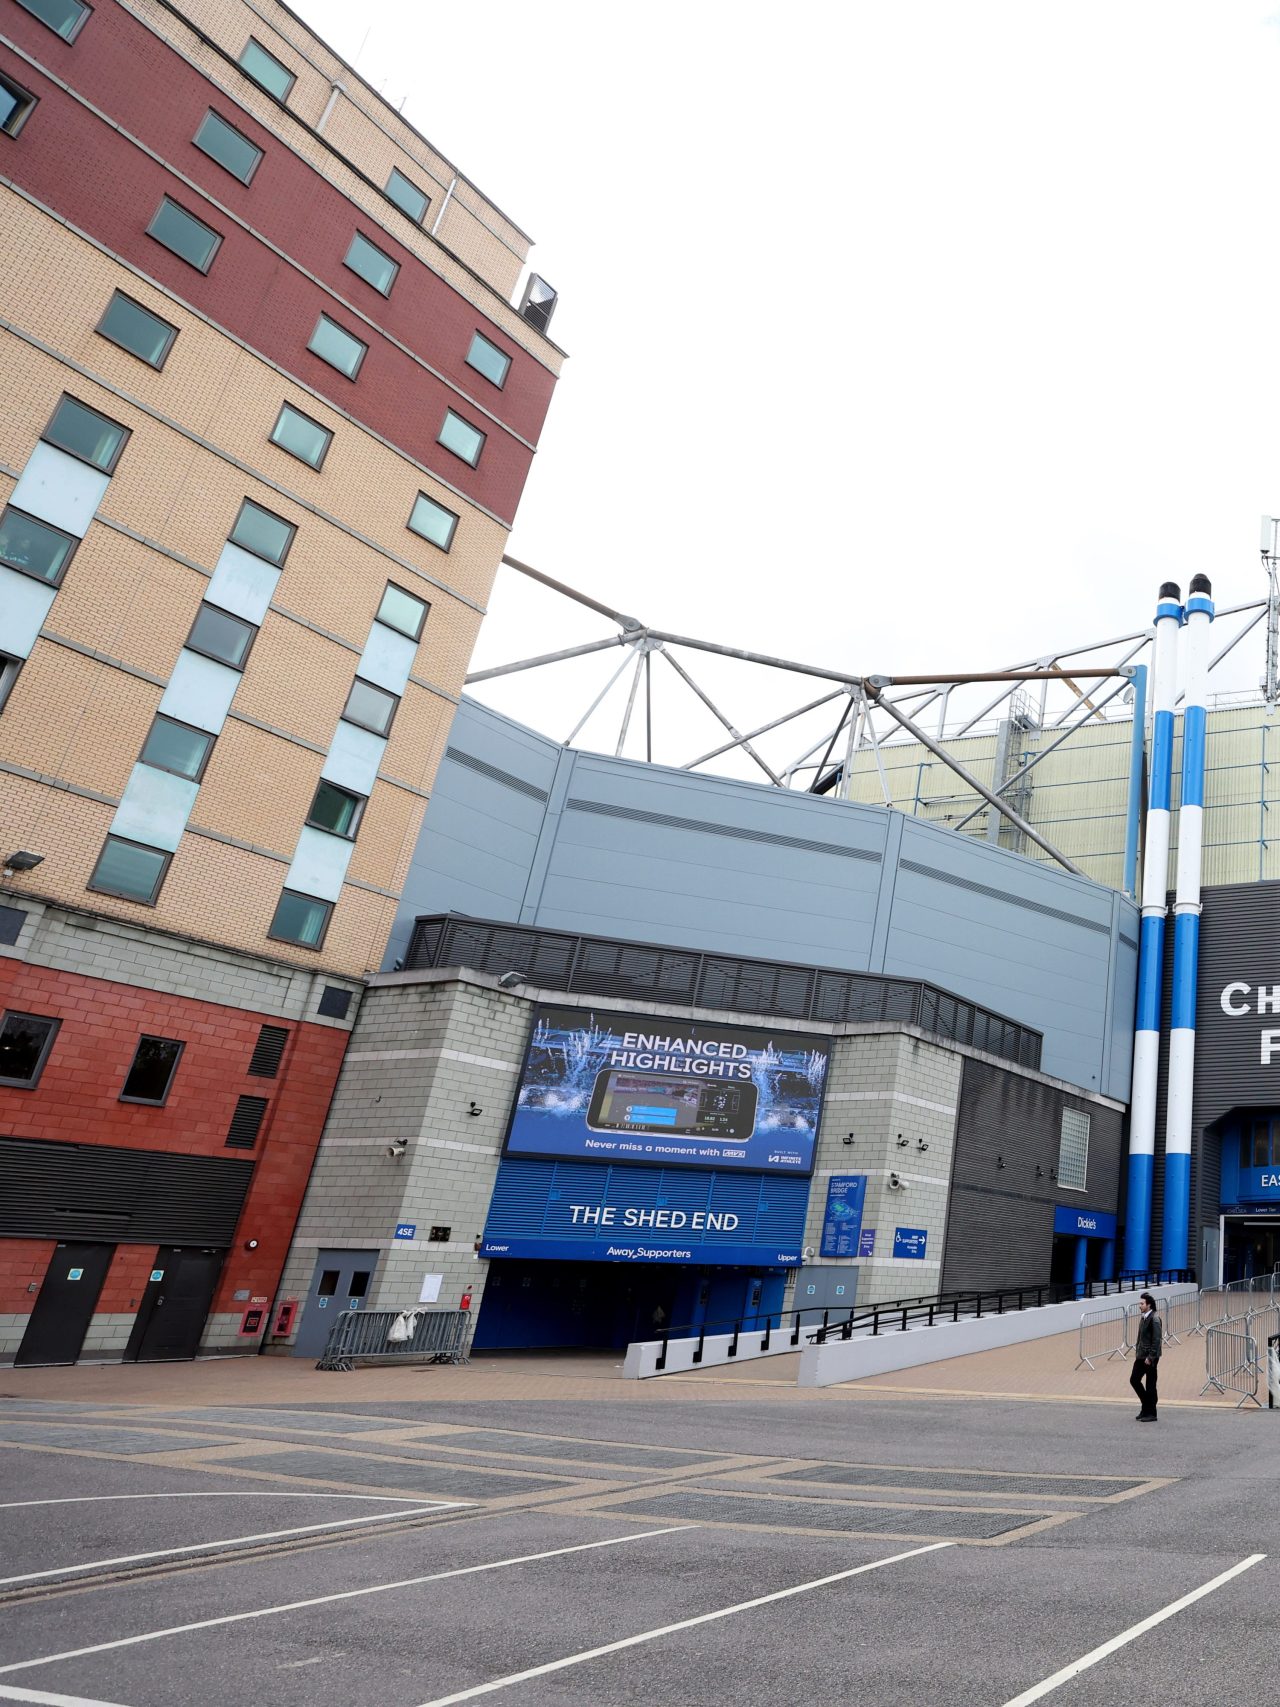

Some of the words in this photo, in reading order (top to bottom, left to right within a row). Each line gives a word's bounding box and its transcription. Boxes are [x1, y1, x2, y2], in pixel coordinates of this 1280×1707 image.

[621, 1032, 747, 1059] ENHANCED
[610, 1051, 752, 1079] HIGHLIGHTS
[585, 1139, 617, 1150] Never
[619, 1142, 643, 1151] miss
[655, 1146, 696, 1155] moment
[699, 1147, 720, 1157] with
[569, 1206, 617, 1226] THE
[623, 1208, 687, 1229] SHED
[691, 1212, 739, 1231] END
[397, 1228, 414, 1236] 4SE
[485, 1244, 509, 1252] Lower
[607, 1247, 635, 1259] Away
[637, 1247, 691, 1260] Supporters
[778, 1254, 798, 1262] Upper
